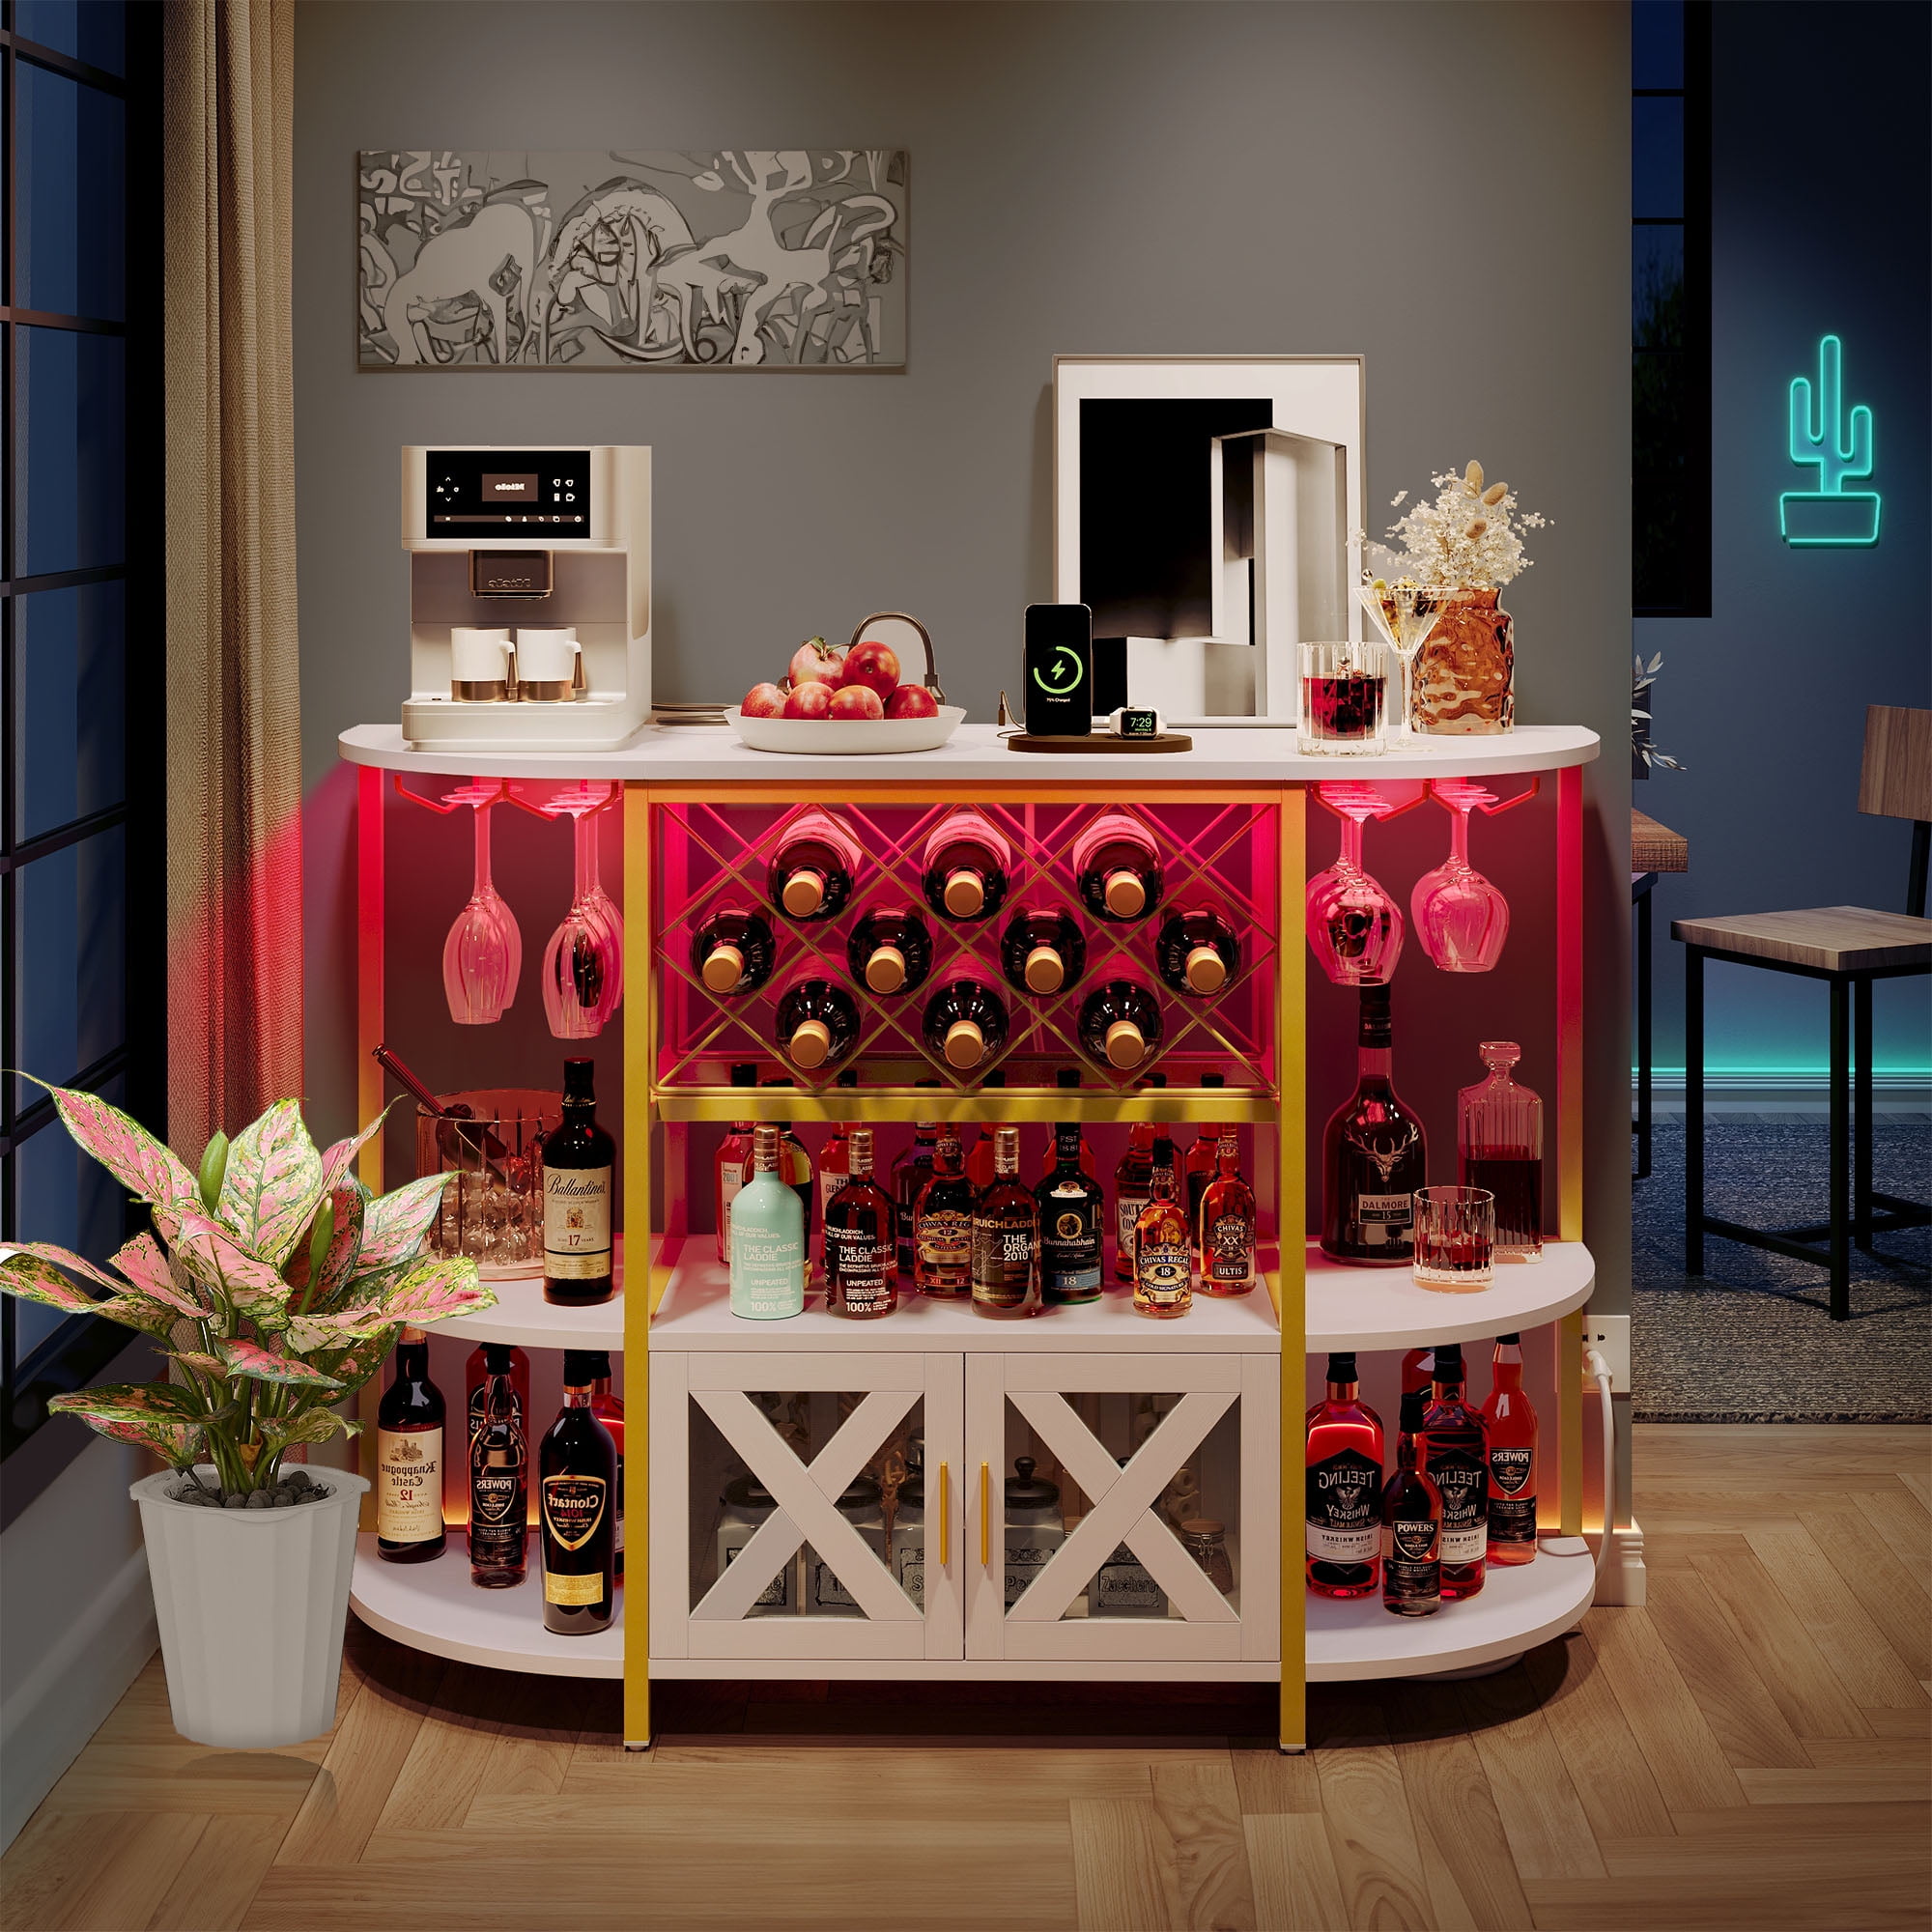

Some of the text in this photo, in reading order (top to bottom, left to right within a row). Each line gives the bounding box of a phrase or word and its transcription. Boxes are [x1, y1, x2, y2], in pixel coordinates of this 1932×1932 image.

[1130, 717, 1152, 728] 7:29
[1362, 1200, 1408, 1209] DALMORE
[1382, 1211, 1391, 1220] 15
[568, 1234, 581, 1246] 17
[1003, 1234, 1027, 1244] THE
[1223, 1236, 1239, 1245] XX
[744, 1242, 798, 1253] THE CLASSIC
[858, 1244, 893, 1254] CLASSIC
[1003, 1240, 1041, 1252] ORGAN
[839, 1254, 873, 1262] LADDIE
[1004, 1252, 1028, 1261] 2010
[1140, 1256, 1165, 1265] CHIVAS
[1160, 1267, 1171, 1276] 18
[1063, 1276, 1077, 1285] 18
[751, 1301, 776, 1311] 100%
[846, 1302, 872, 1312] 100%
[1397, 1524, 1434, 1532] POWERS
